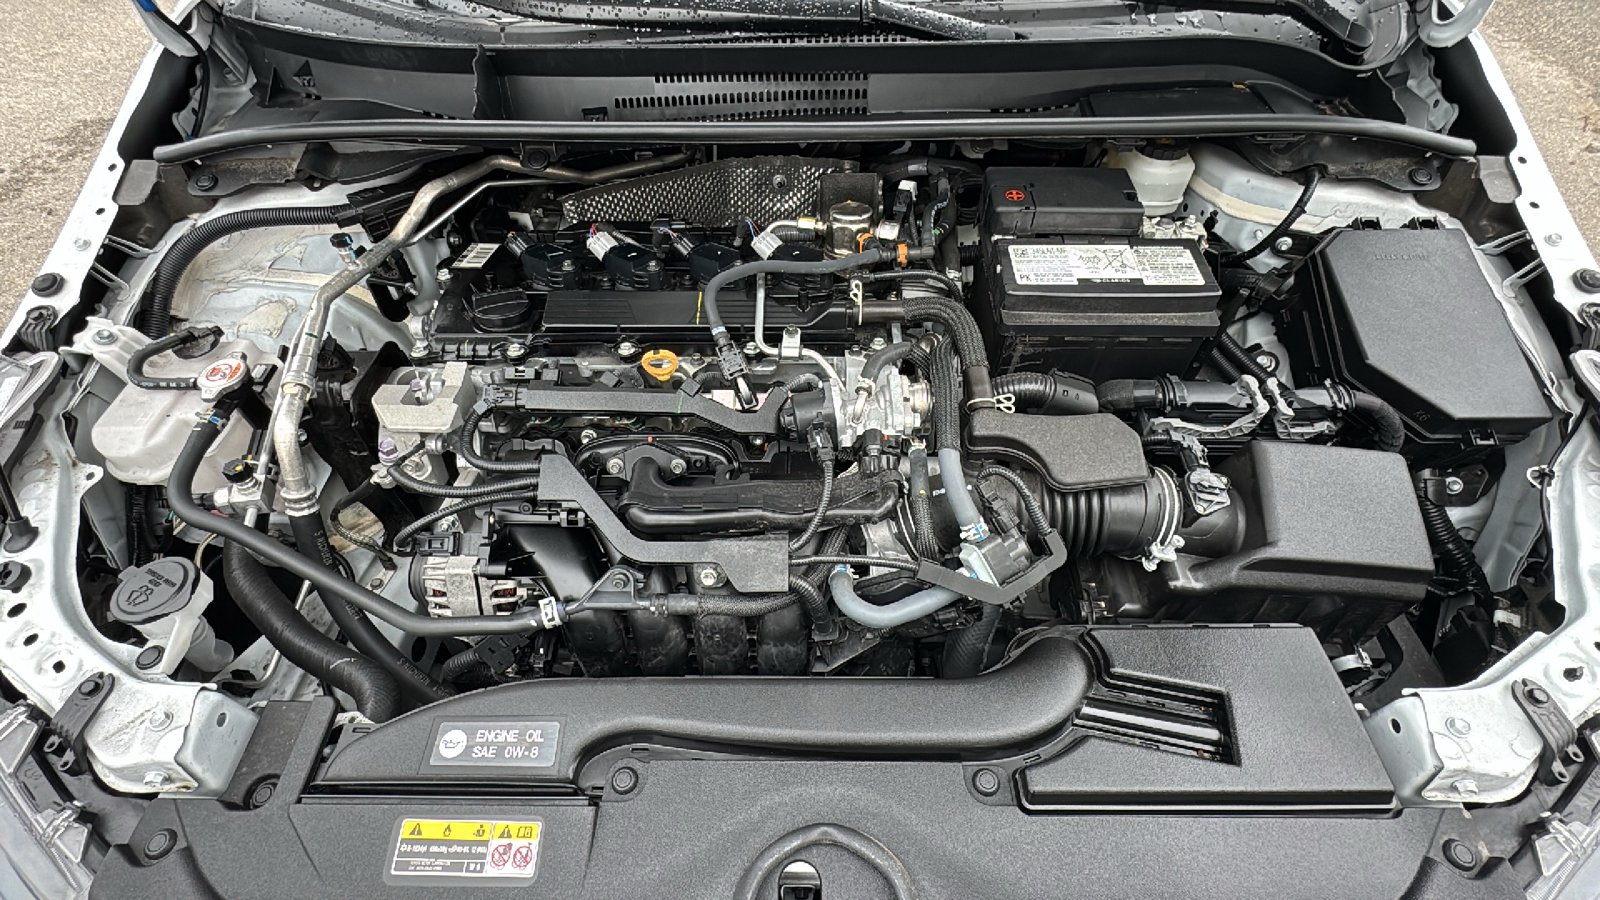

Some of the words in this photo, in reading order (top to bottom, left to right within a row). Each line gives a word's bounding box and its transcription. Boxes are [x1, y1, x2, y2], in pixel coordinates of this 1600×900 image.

[1019, 273, 1033, 282] PK
[475, 729, 520, 742] ENGINE
[525, 729, 545, 742] OIL
[471, 745, 498, 758] SAE
[504, 745, 540, 758] 0W-8
